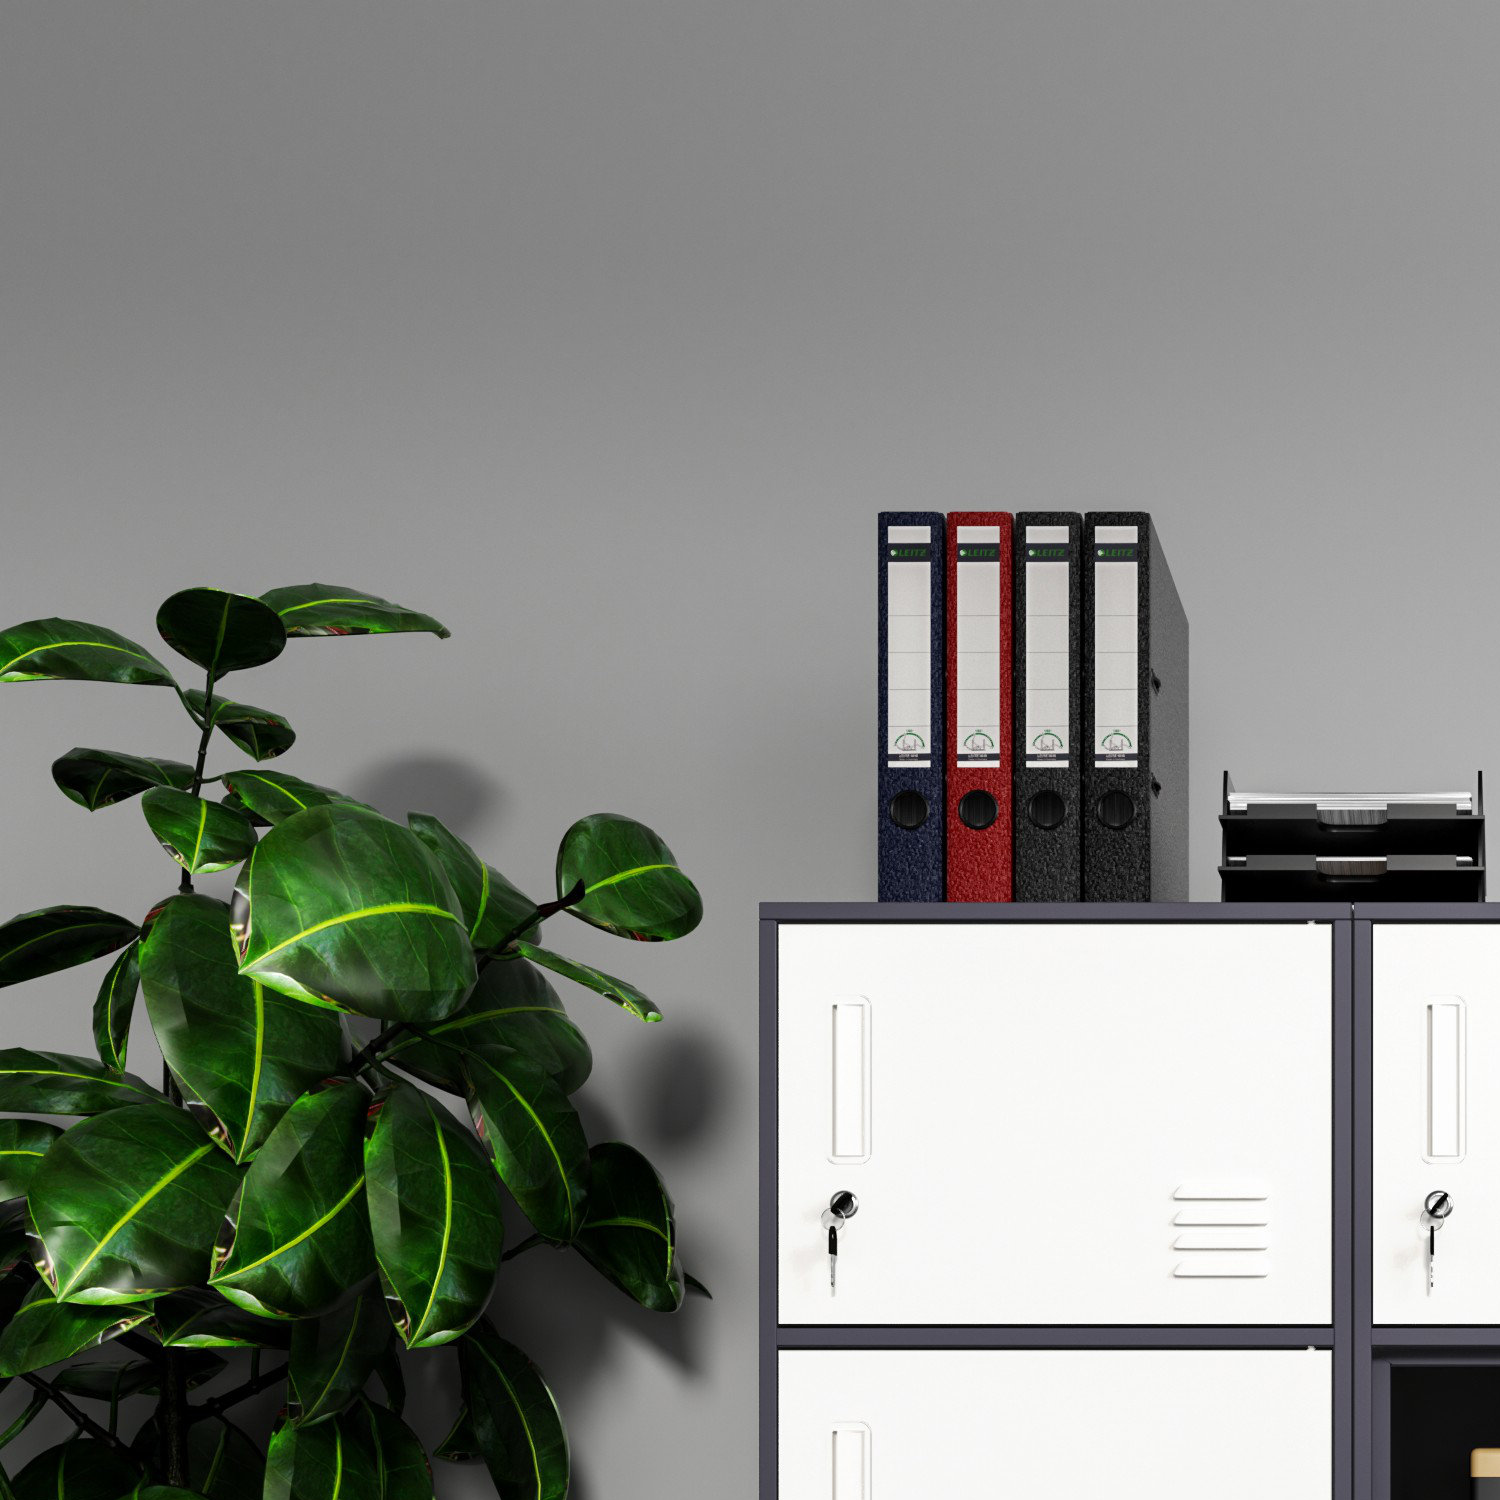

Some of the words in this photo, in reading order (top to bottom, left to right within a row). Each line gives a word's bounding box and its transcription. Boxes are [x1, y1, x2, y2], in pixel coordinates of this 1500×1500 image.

[898, 548, 927, 557] LEITZ
[967, 548, 996, 557] LEITZ
[1036, 548, 1065, 557] LEITZ
[1105, 548, 1134, 557] LEITZ
